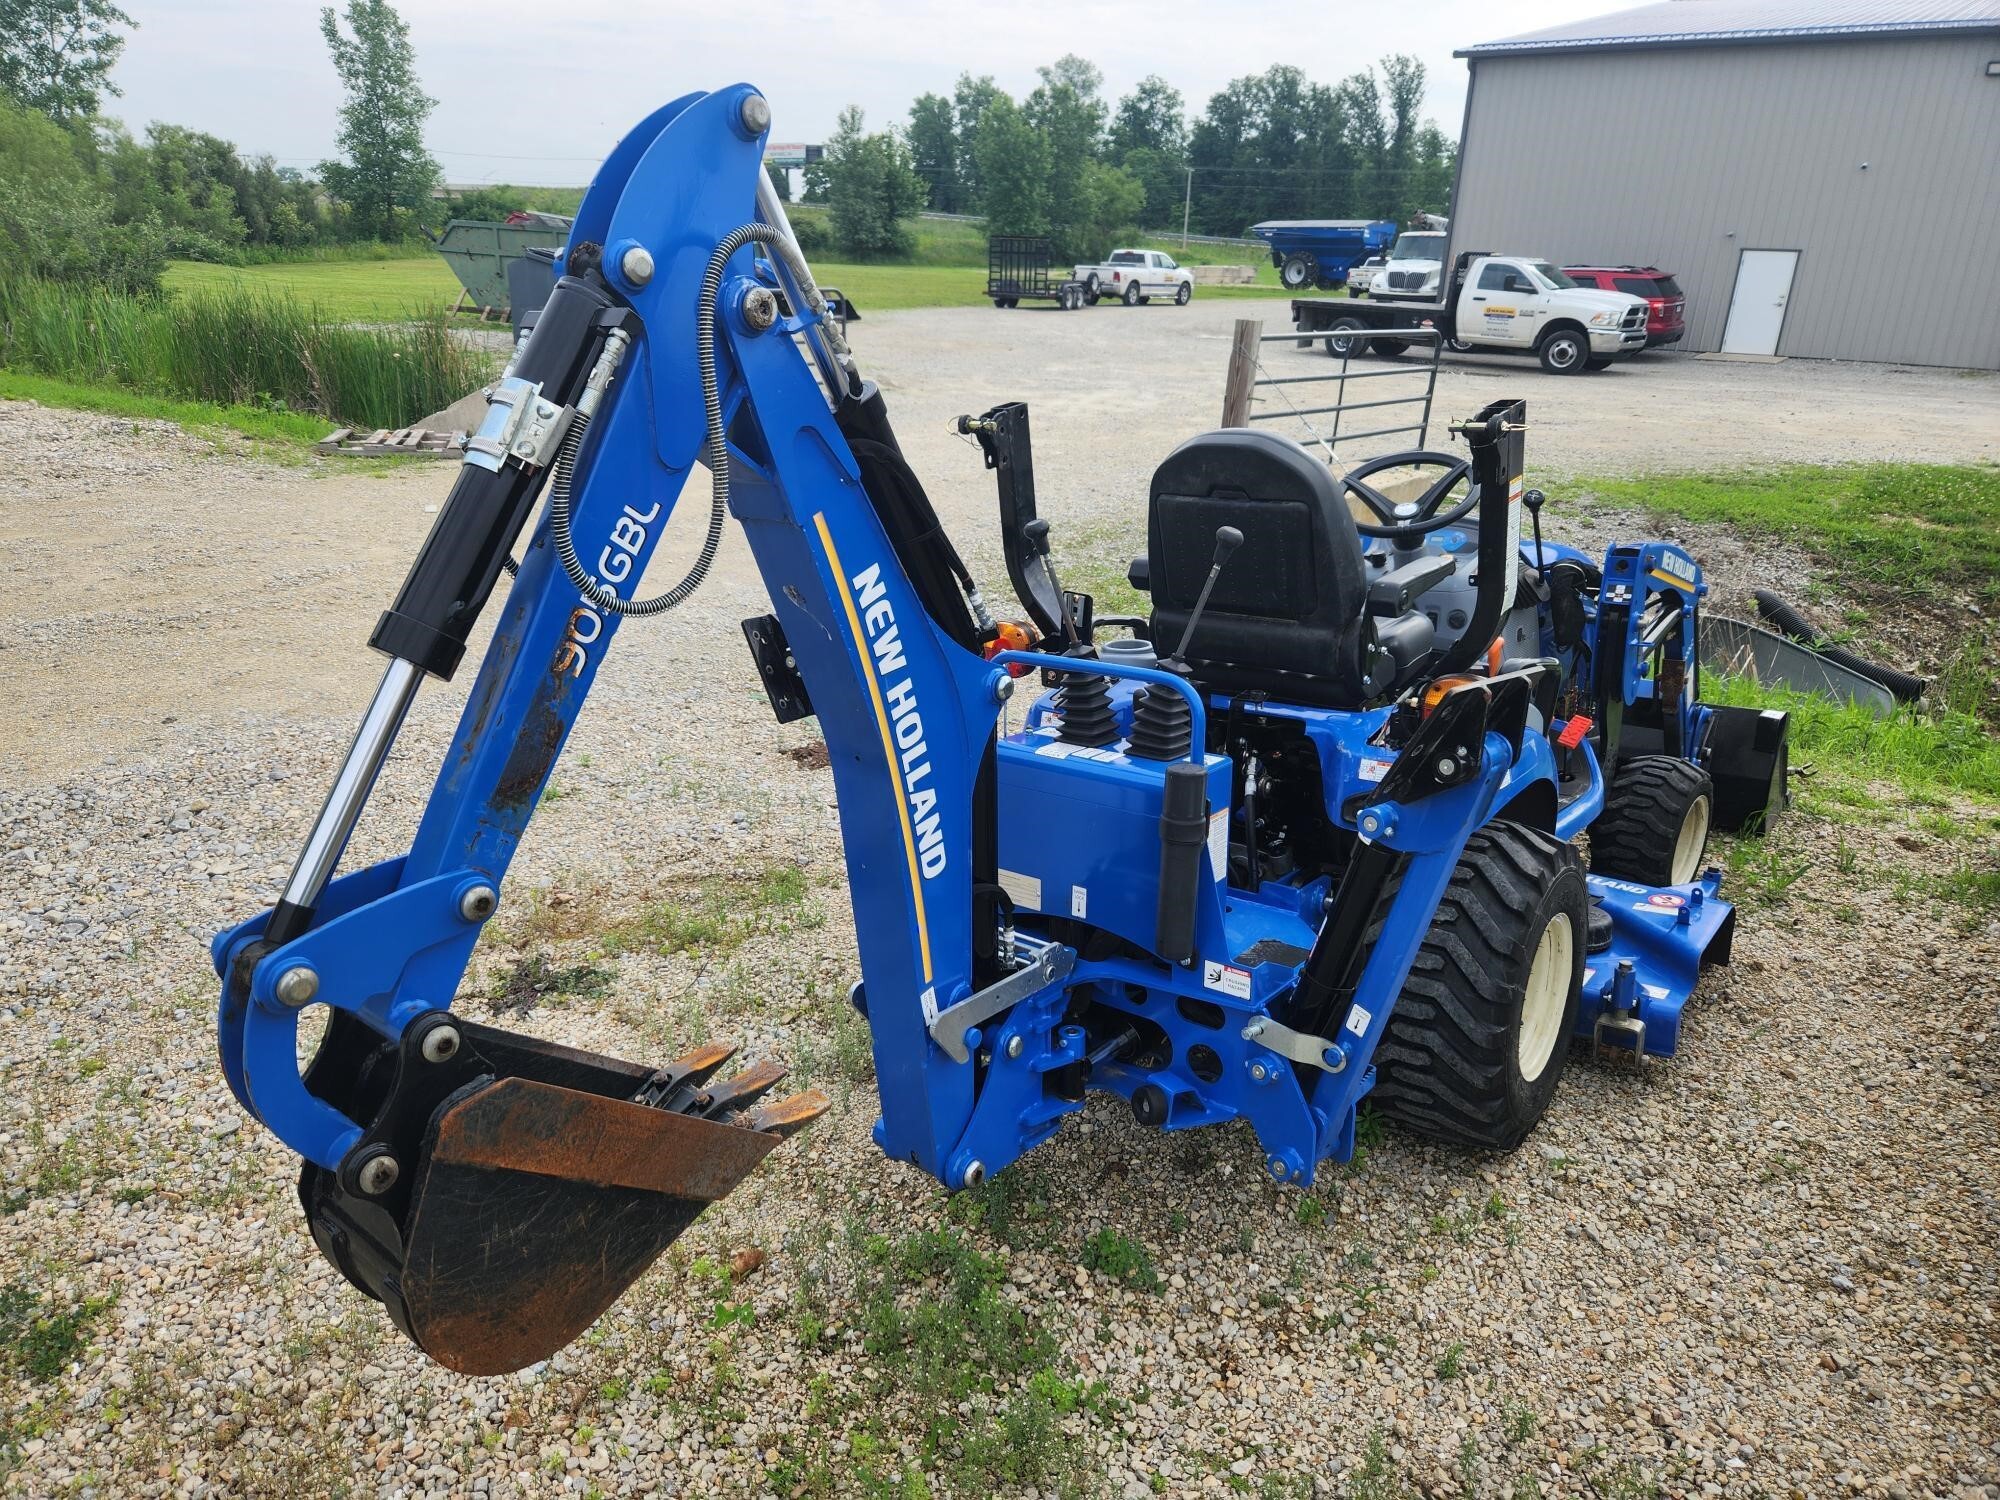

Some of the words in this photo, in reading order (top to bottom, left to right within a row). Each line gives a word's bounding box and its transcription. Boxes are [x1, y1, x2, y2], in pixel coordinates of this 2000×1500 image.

[1662, 549, 1676, 572] NEW
[1673, 556, 1696, 583] HOLLAND
[852, 562, 906, 676] NEW
[886, 677, 947, 880] HOLLAND
